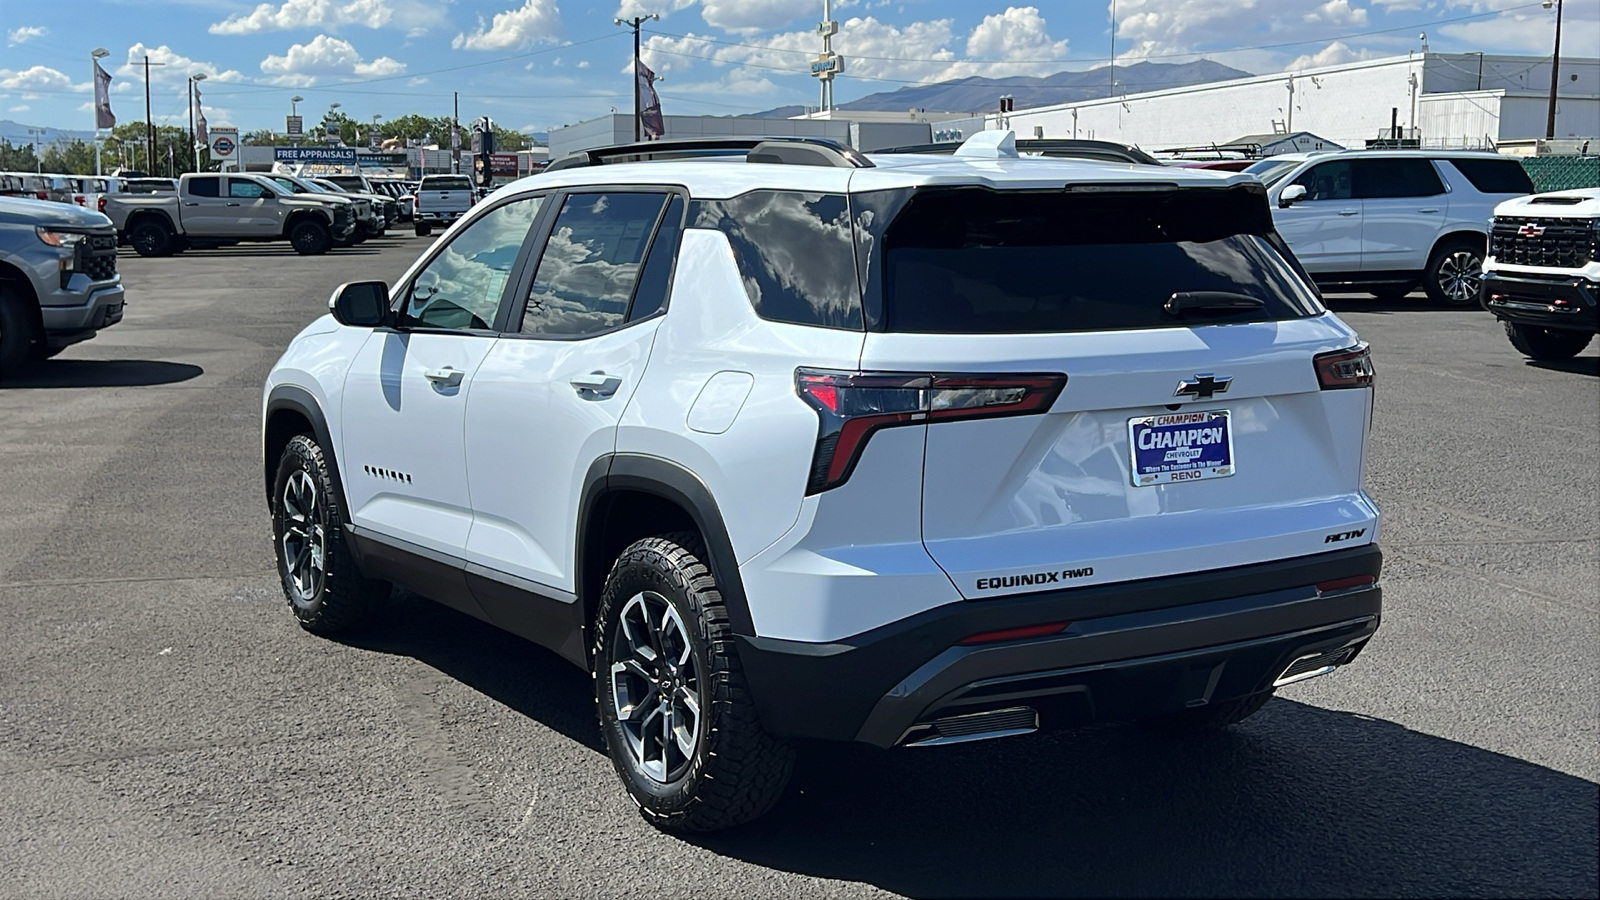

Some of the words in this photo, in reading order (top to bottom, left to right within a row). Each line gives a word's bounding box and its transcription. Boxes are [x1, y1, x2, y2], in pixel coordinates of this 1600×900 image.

[277, 150, 298, 158] FREE
[300, 150, 354, 159] APPRAISALS!
[1157, 413, 1205, 426] CHAMPION
[1138, 427, 1223, 450] CHAMPION
[1166, 450, 1201, 459] CHEVROLET
[1171, 470, 1202, 481] RENO
[1324, 527, 1368, 544] ACTIV
[976, 571, 1059, 590] EQUINOX
[1062, 567, 1095, 580] AWD
